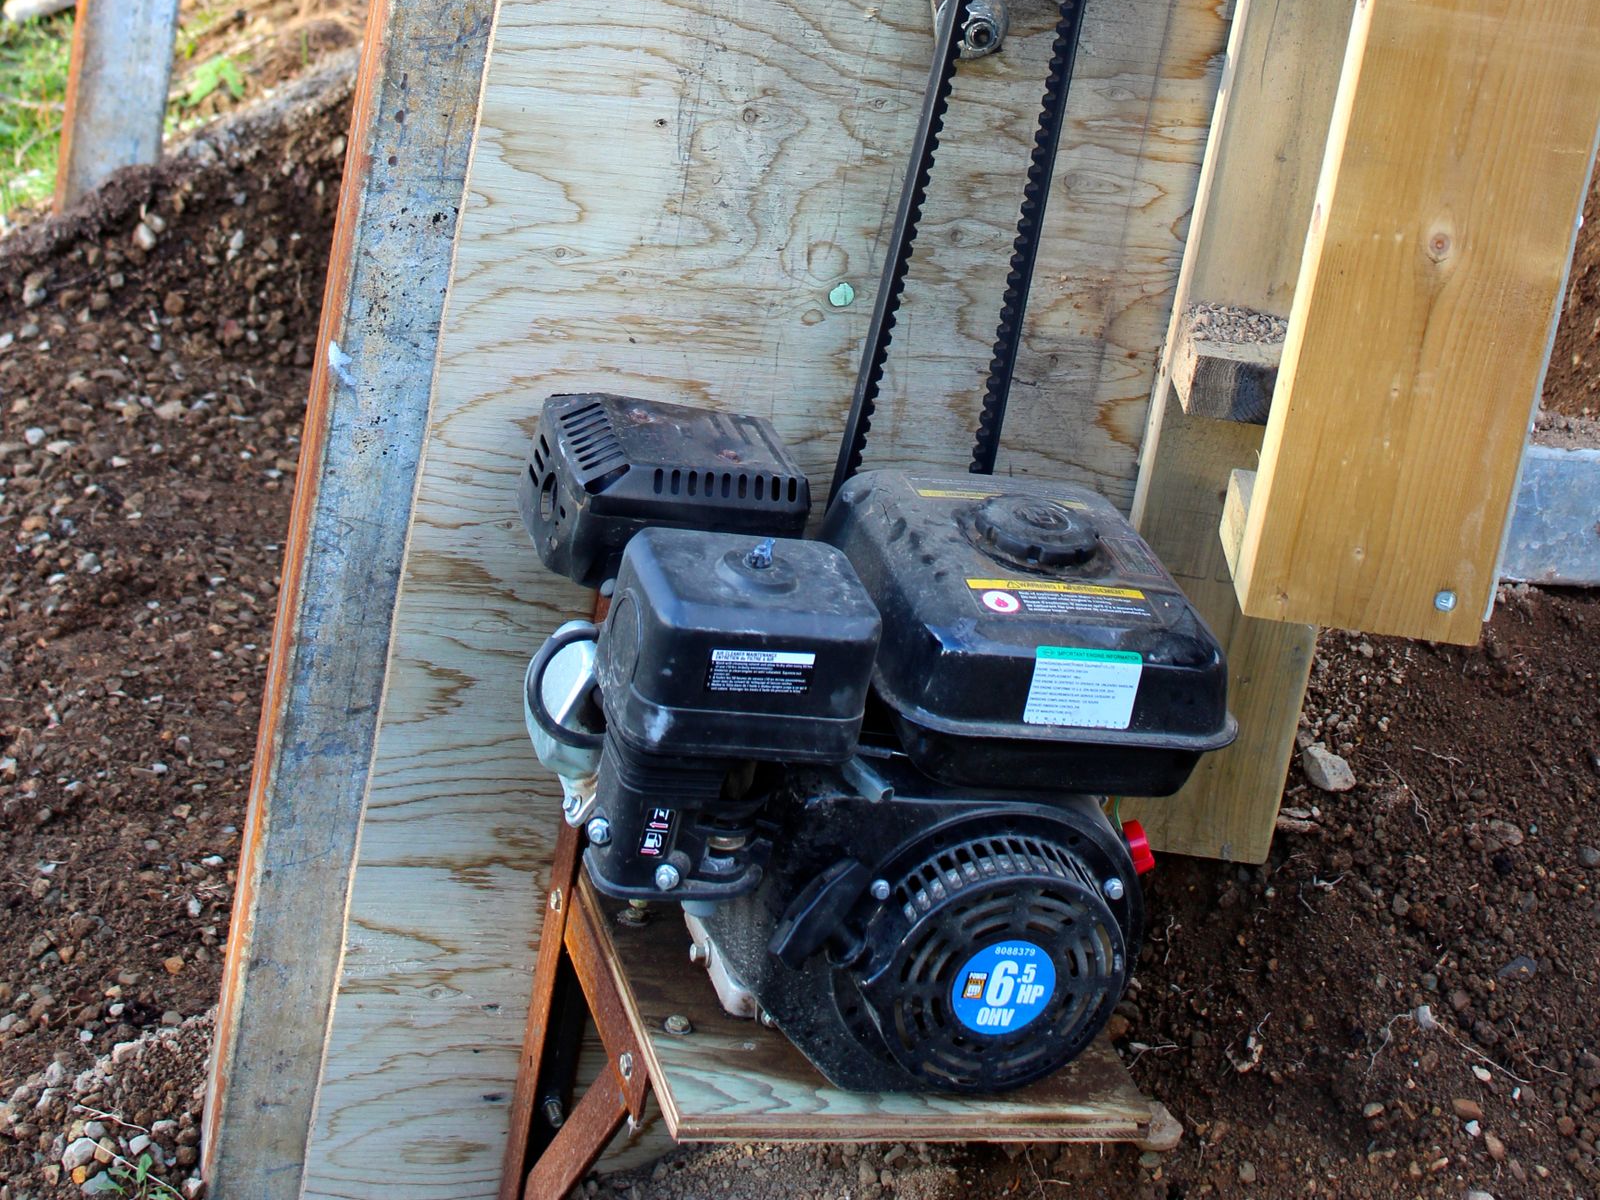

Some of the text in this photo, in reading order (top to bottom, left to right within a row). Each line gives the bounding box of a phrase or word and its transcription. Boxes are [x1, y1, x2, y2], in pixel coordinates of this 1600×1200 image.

[1020, 582, 1056, 590] WARNING
[994, 946, 1036, 956] 8088379
[969, 972, 987, 980] POWER
[1016, 984, 1044, 1004] HP
[976, 1007, 1015, 1026] OHV
